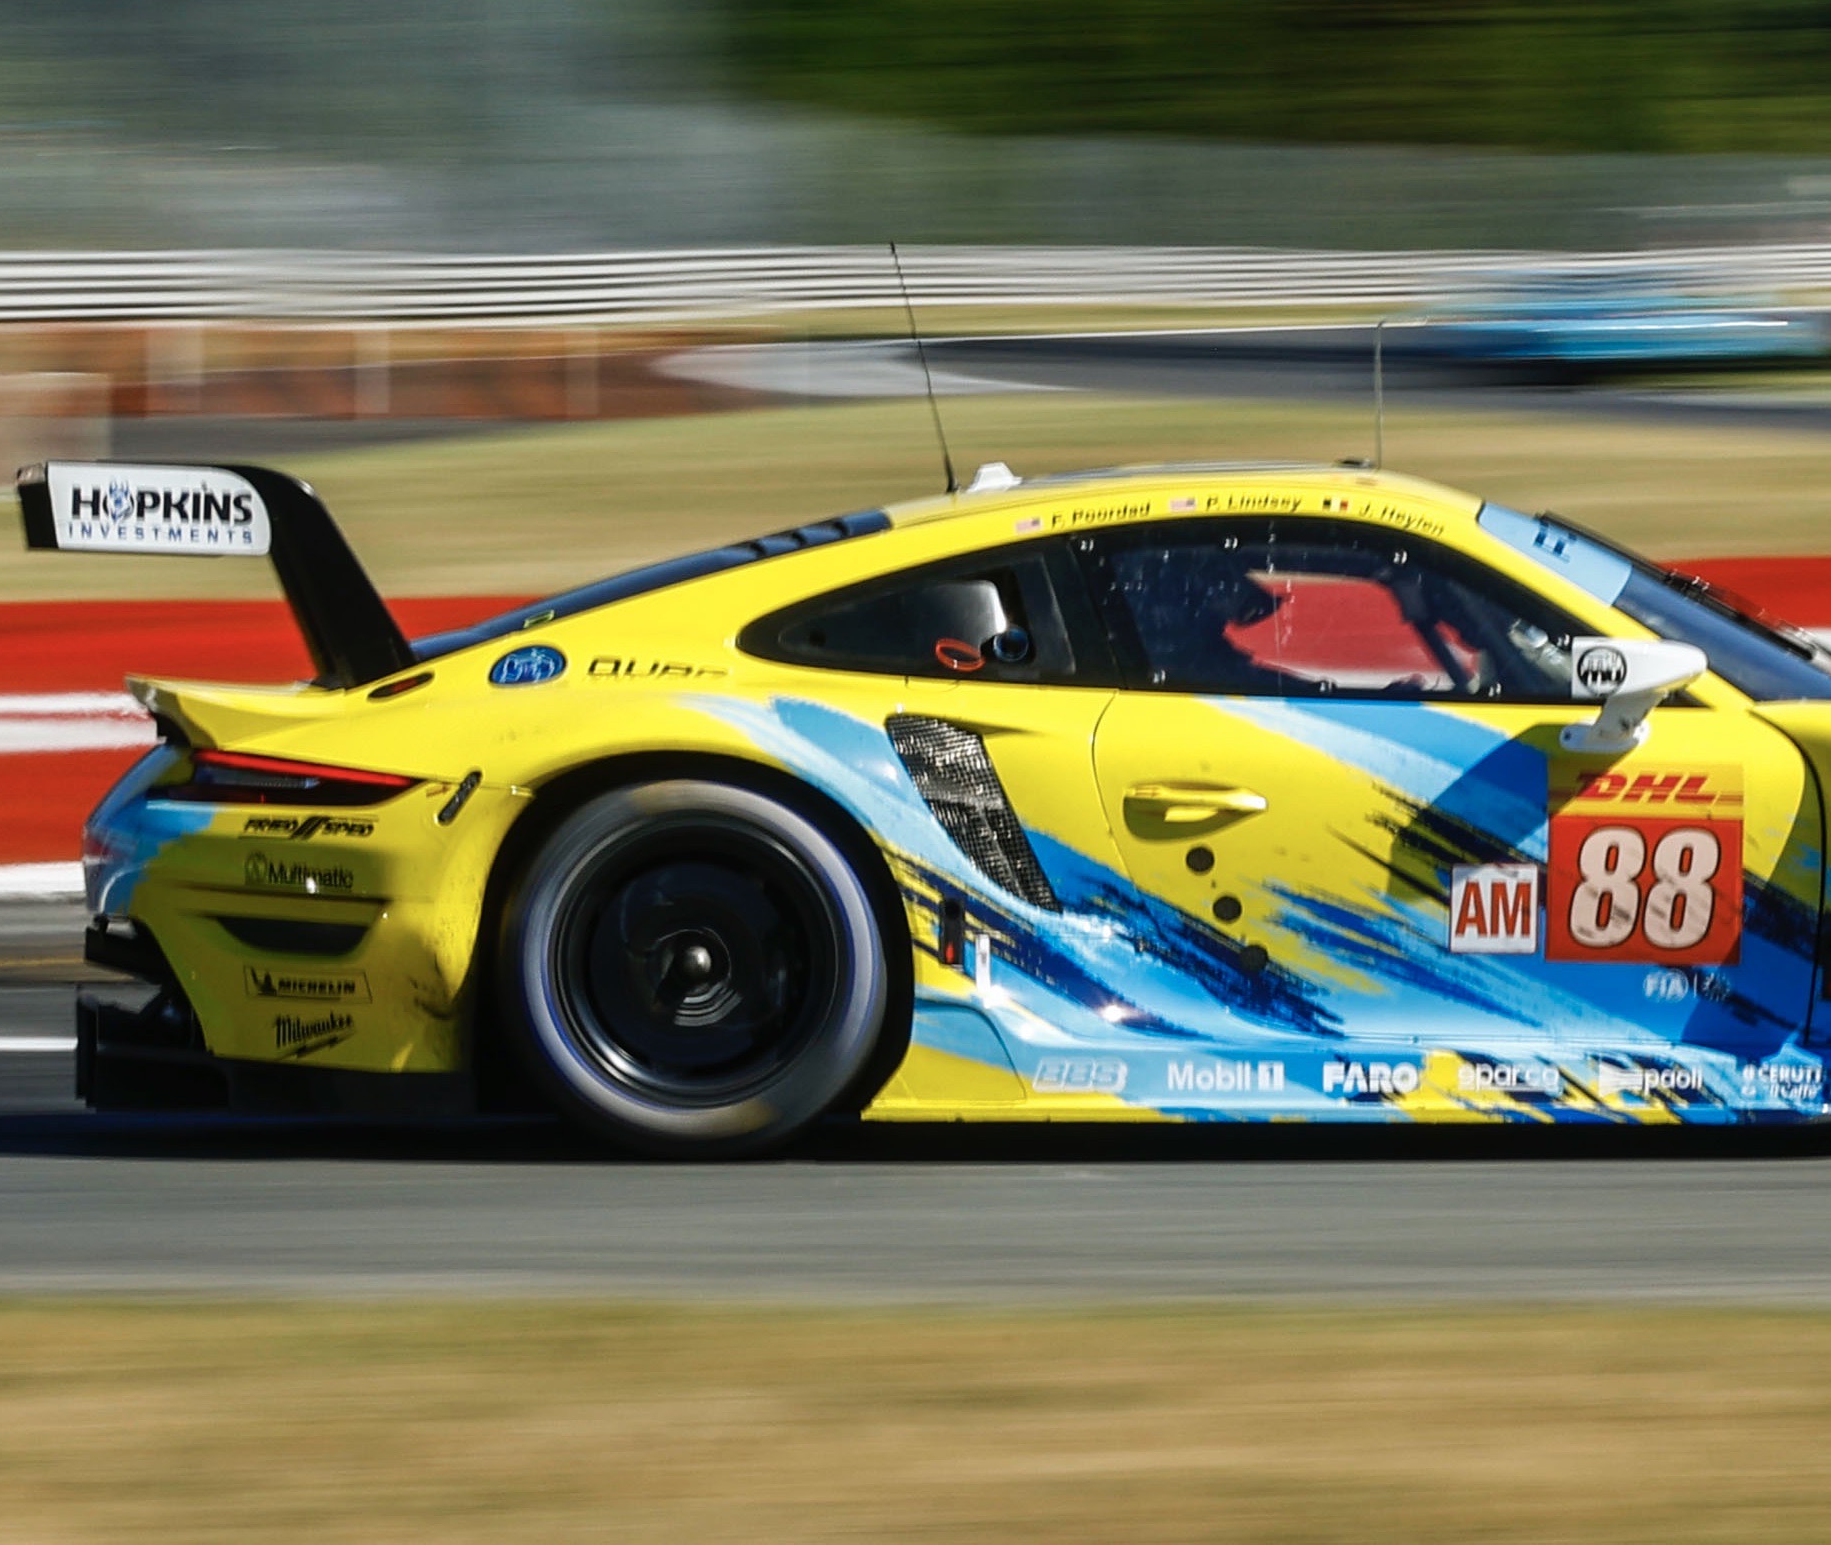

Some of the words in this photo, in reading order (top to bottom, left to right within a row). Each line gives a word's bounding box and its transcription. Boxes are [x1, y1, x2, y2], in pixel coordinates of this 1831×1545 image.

[72, 484, 253, 525] HOPKINS
[68, 522, 253, 545] INVESTMENTS
[1576, 773, 1716, 803] DHL
[268, 860, 354, 889] Multimatic
[1569, 825, 1721, 950] 88
[1455, 881, 1531, 938] AM
[278, 978, 355, 994] MICHELIN
[1644, 971, 1687, 1000] FIA
[1168, 1060, 1252, 1091] Mobil
[1323, 1062, 1418, 1094] FARO
[1643, 1067, 1703, 1096] paoli
